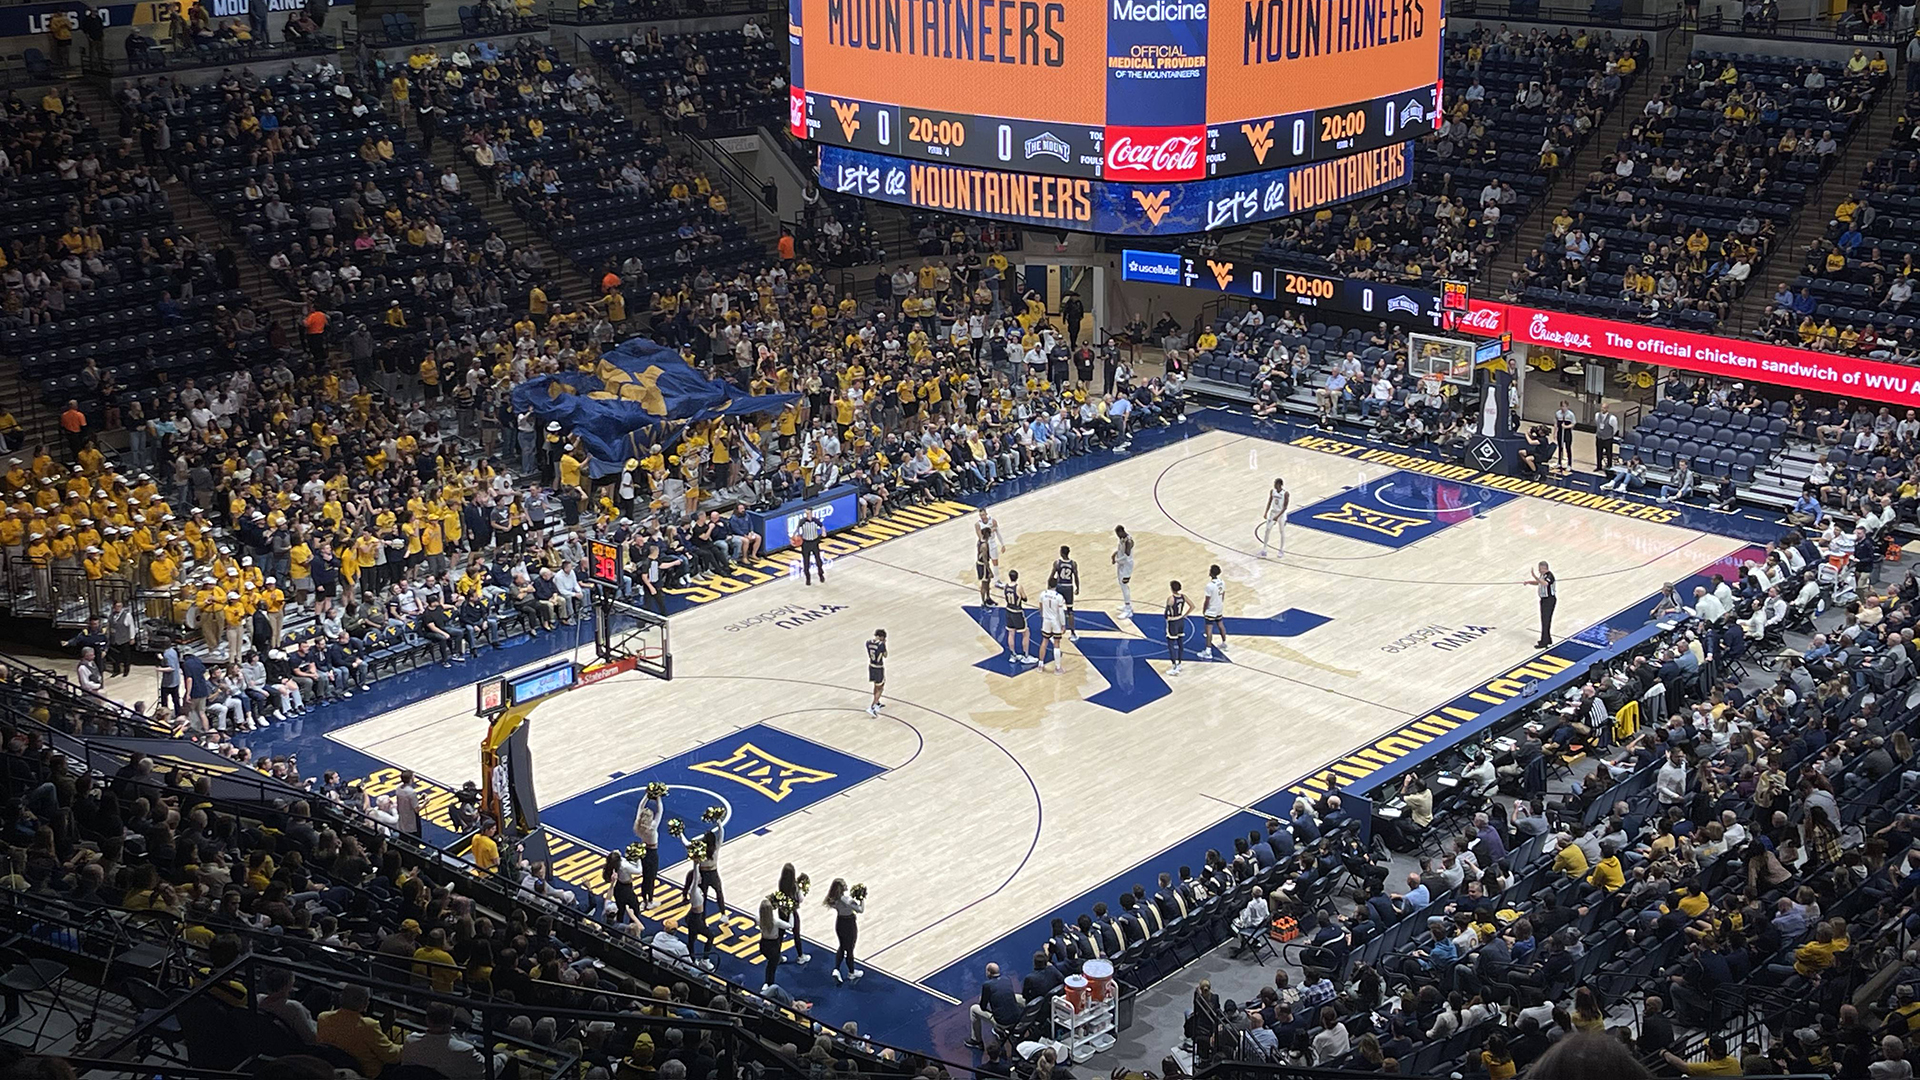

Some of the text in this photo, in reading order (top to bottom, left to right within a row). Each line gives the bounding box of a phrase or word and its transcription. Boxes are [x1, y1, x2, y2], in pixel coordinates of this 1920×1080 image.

[1113, 0, 1207, 21] Medicine
[828, 0, 1065, 67] MOUNTAINEERS
[1243, 0, 1424, 65] MOUNTAINEERS
[1108, 56, 1206, 69] MEDICAL PROVIDER
[1130, 45, 1187, 58] OFFICIAL
[1115, 69, 1200, 79] OF THE MOUNTAINEERS
[878, 110, 890, 145] 0
[1320, 109, 1366, 142] 20:00
[1385, 101, 1395, 136] 0
[908, 116, 965, 147] 20:00
[1089, 131, 1104, 141] TOL
[1207, 129, 1219, 138] TOL
[1293, 119, 1305, 155] 0
[998, 125, 1012, 162] 0
[1026, 140, 1042, 155] THE
[1094, 140, 1101, 153] 4
[1107, 136, 1203, 171] Coca-Cola
[1210, 138, 1216, 150] 4
[1080, 154, 1104, 165] FOULS
[1206, 152, 1226, 163] FOULS
[1095, 164, 1101, 176] 0
[837, 164, 1091, 222] LET'S GO MOUNTAINEERS
[1204, 142, 1405, 231] LET'S GO MOUNTAINEERS
[1252, 271, 1262, 294] 0
[1285, 273, 1334, 299] 20:00
[1444, 282, 1467, 294] 20:00
[1362, 288, 1374, 312] 0
[1604, 332, 1634, 350] The
[1636, 339, 1692, 359] official
[1694, 346, 1758, 370] chicken
[1761, 356, 1838, 382] sandwich
[1841, 369, 1863, 385] of
[1865, 373, 1908, 393] WVU
[1290, 435, 1683, 525] WEST VIRGINIA MOUNTAINEERS
[1060, 567, 1072, 580] 42
[1006, 592, 1016, 605] 11
